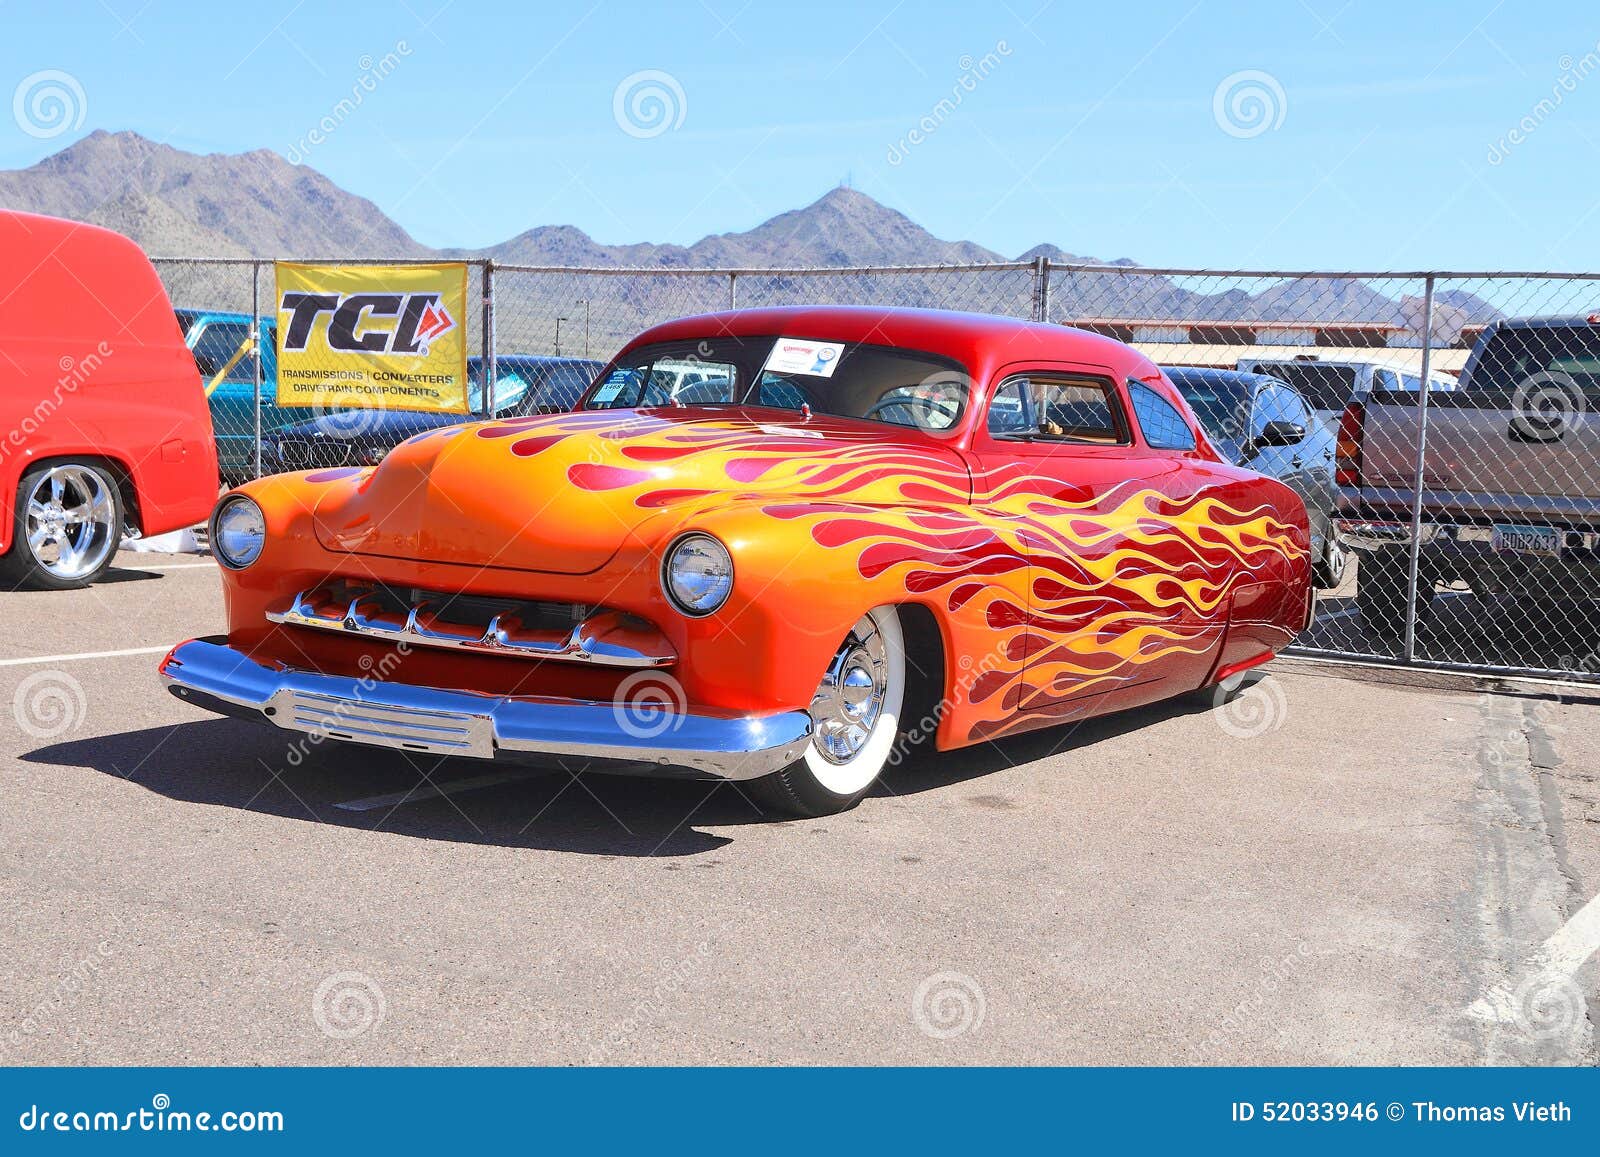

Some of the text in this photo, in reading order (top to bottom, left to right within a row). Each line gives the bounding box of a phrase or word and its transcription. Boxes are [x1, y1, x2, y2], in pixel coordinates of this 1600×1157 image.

[282, 369, 453, 385] TRANSMISSIONS CONVERTERS
[293, 383, 440, 397] DRIVETRAIN COMPONENTS
